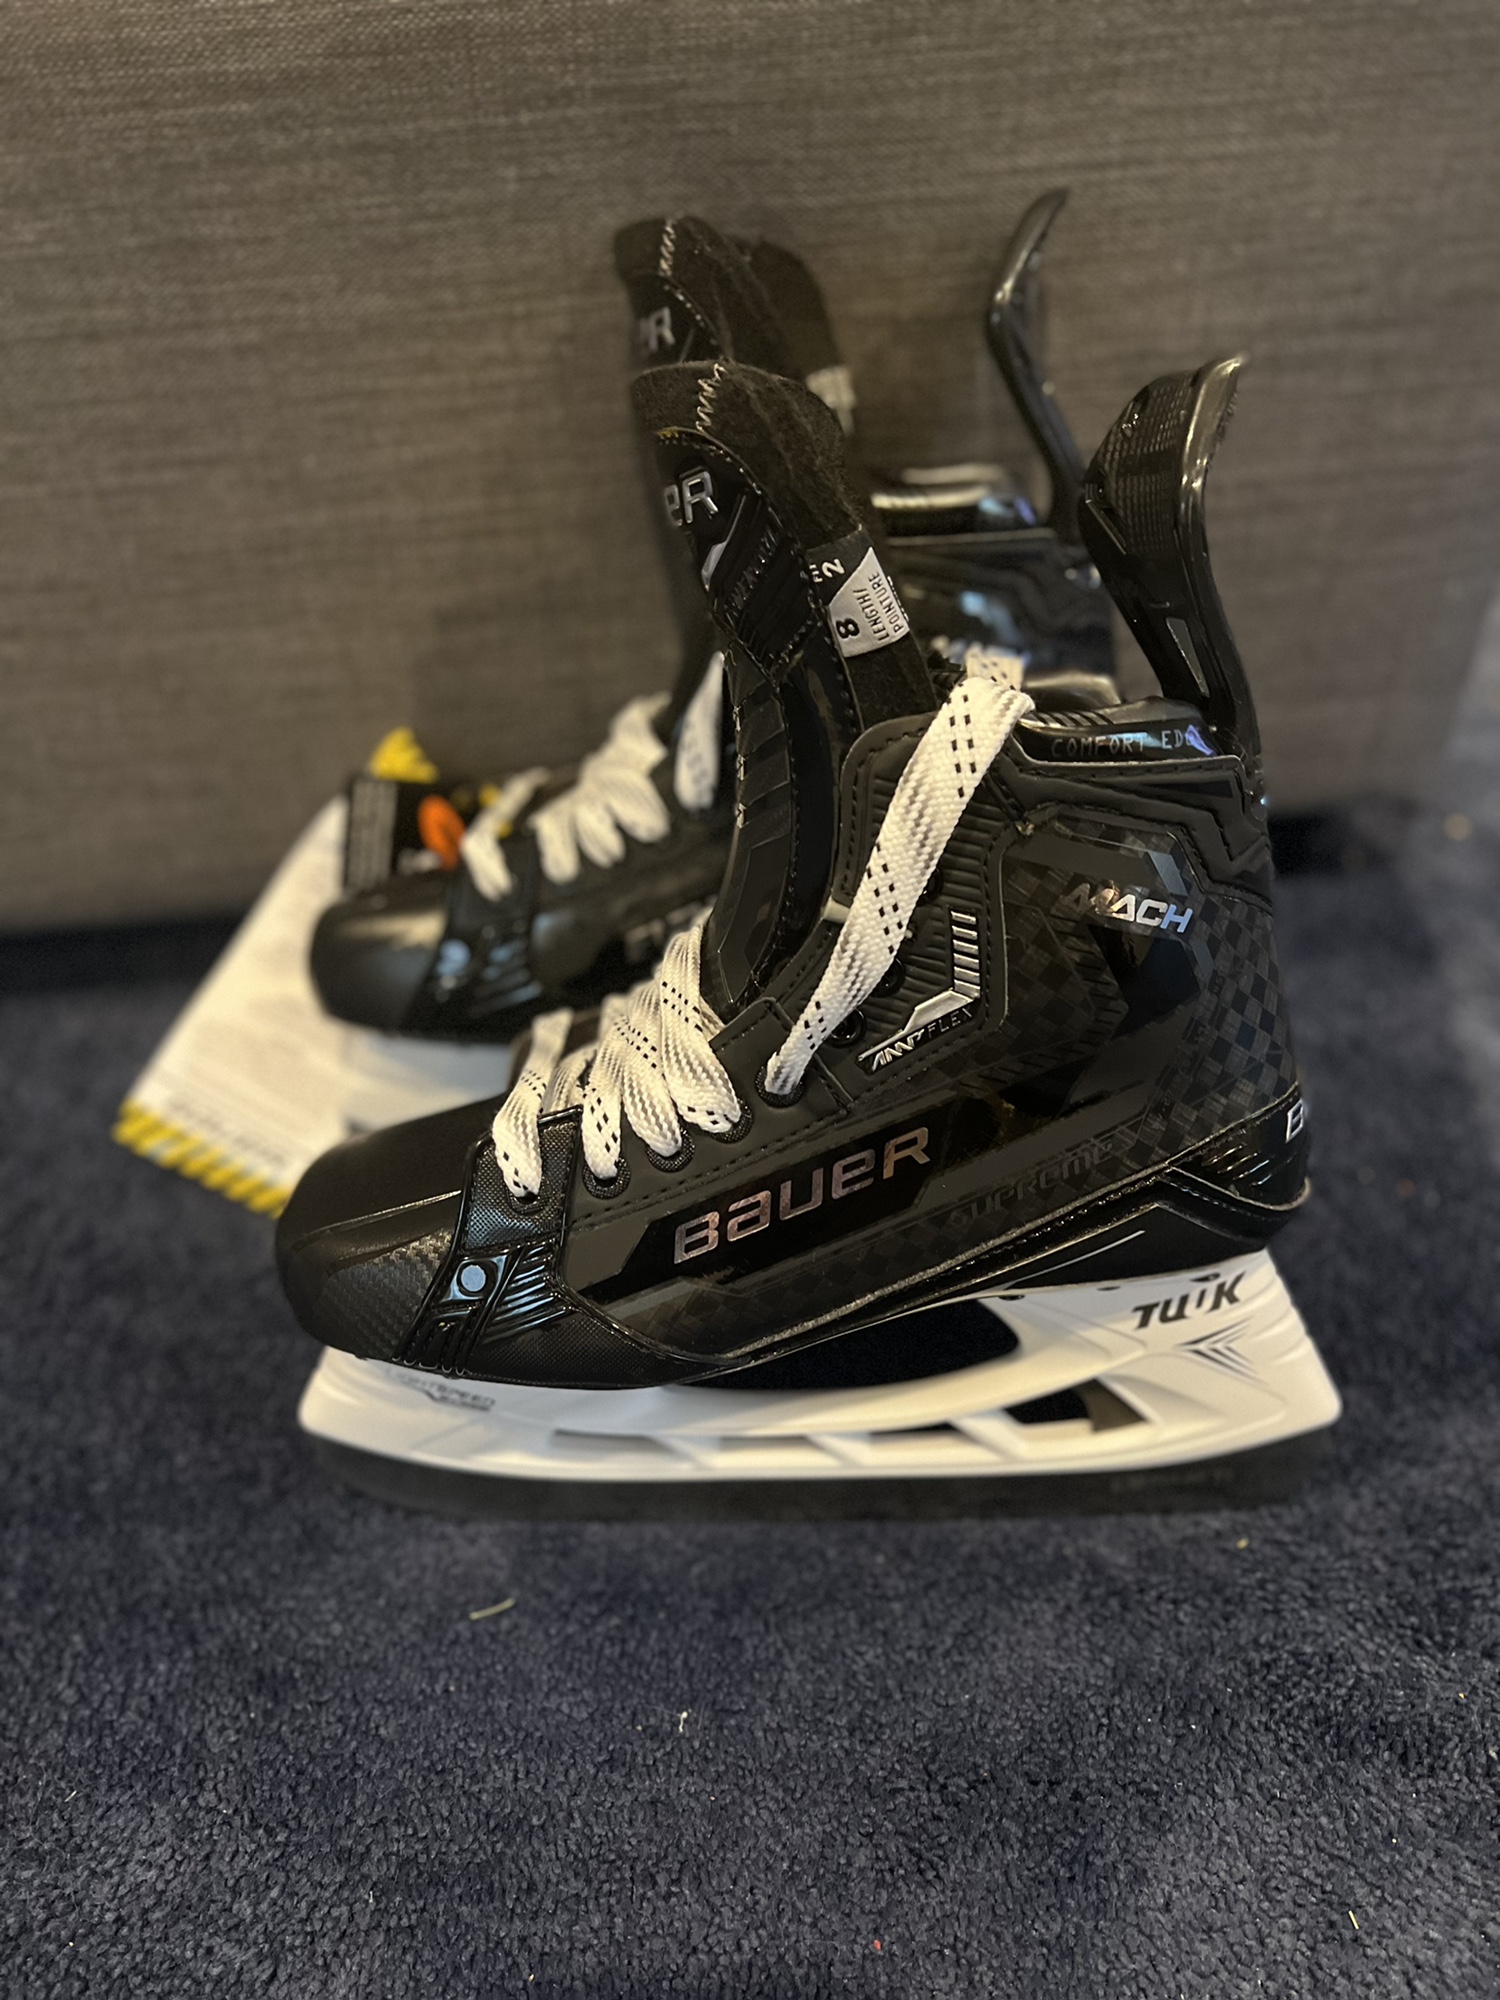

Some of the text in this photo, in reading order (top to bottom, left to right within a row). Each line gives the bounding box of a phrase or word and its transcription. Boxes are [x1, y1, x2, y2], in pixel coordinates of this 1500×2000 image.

[821, 558, 845, 578] 2
[869, 572, 905, 633] POINTURE
[836, 618, 860, 639] 8
[1051, 732, 1147, 758] COMFORT
